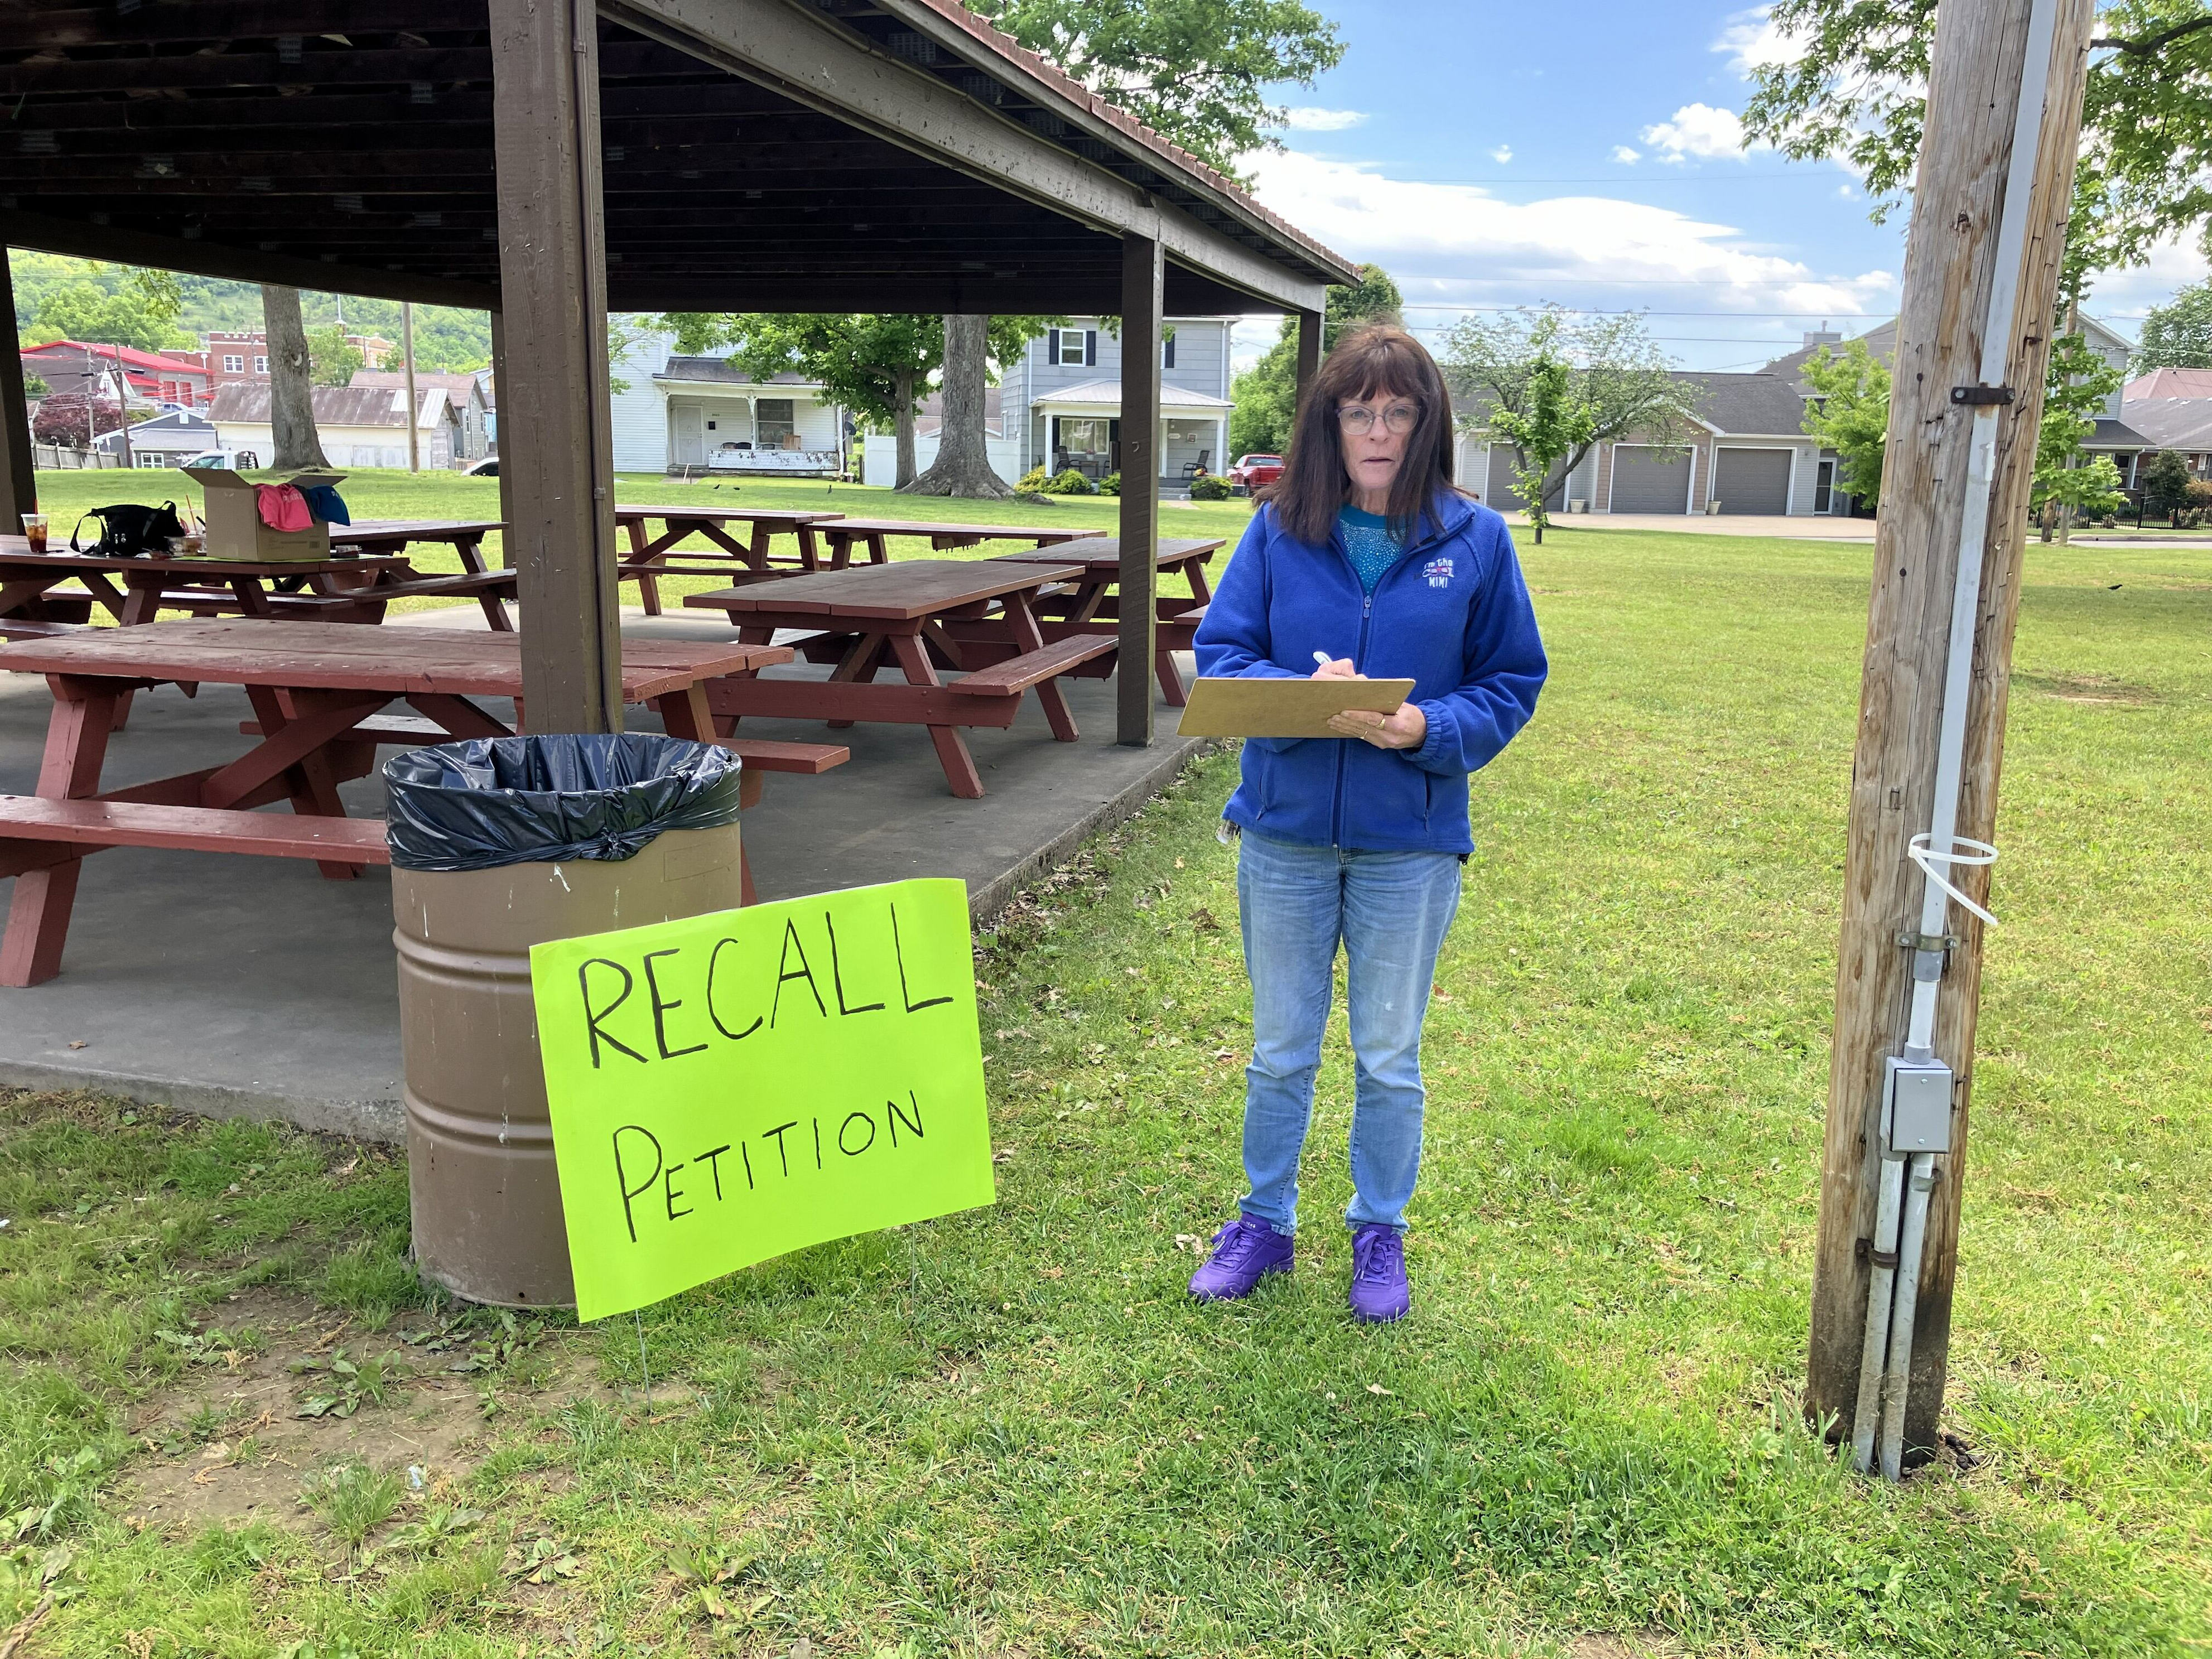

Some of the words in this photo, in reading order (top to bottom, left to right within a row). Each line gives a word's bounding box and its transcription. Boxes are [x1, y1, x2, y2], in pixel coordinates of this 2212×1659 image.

[1429, 576, 1448, 589] MIMI
[1436, 557, 1453, 567] the
[578, 903, 955, 1069] RECALL
[613, 1090, 924, 1243] PETITION
